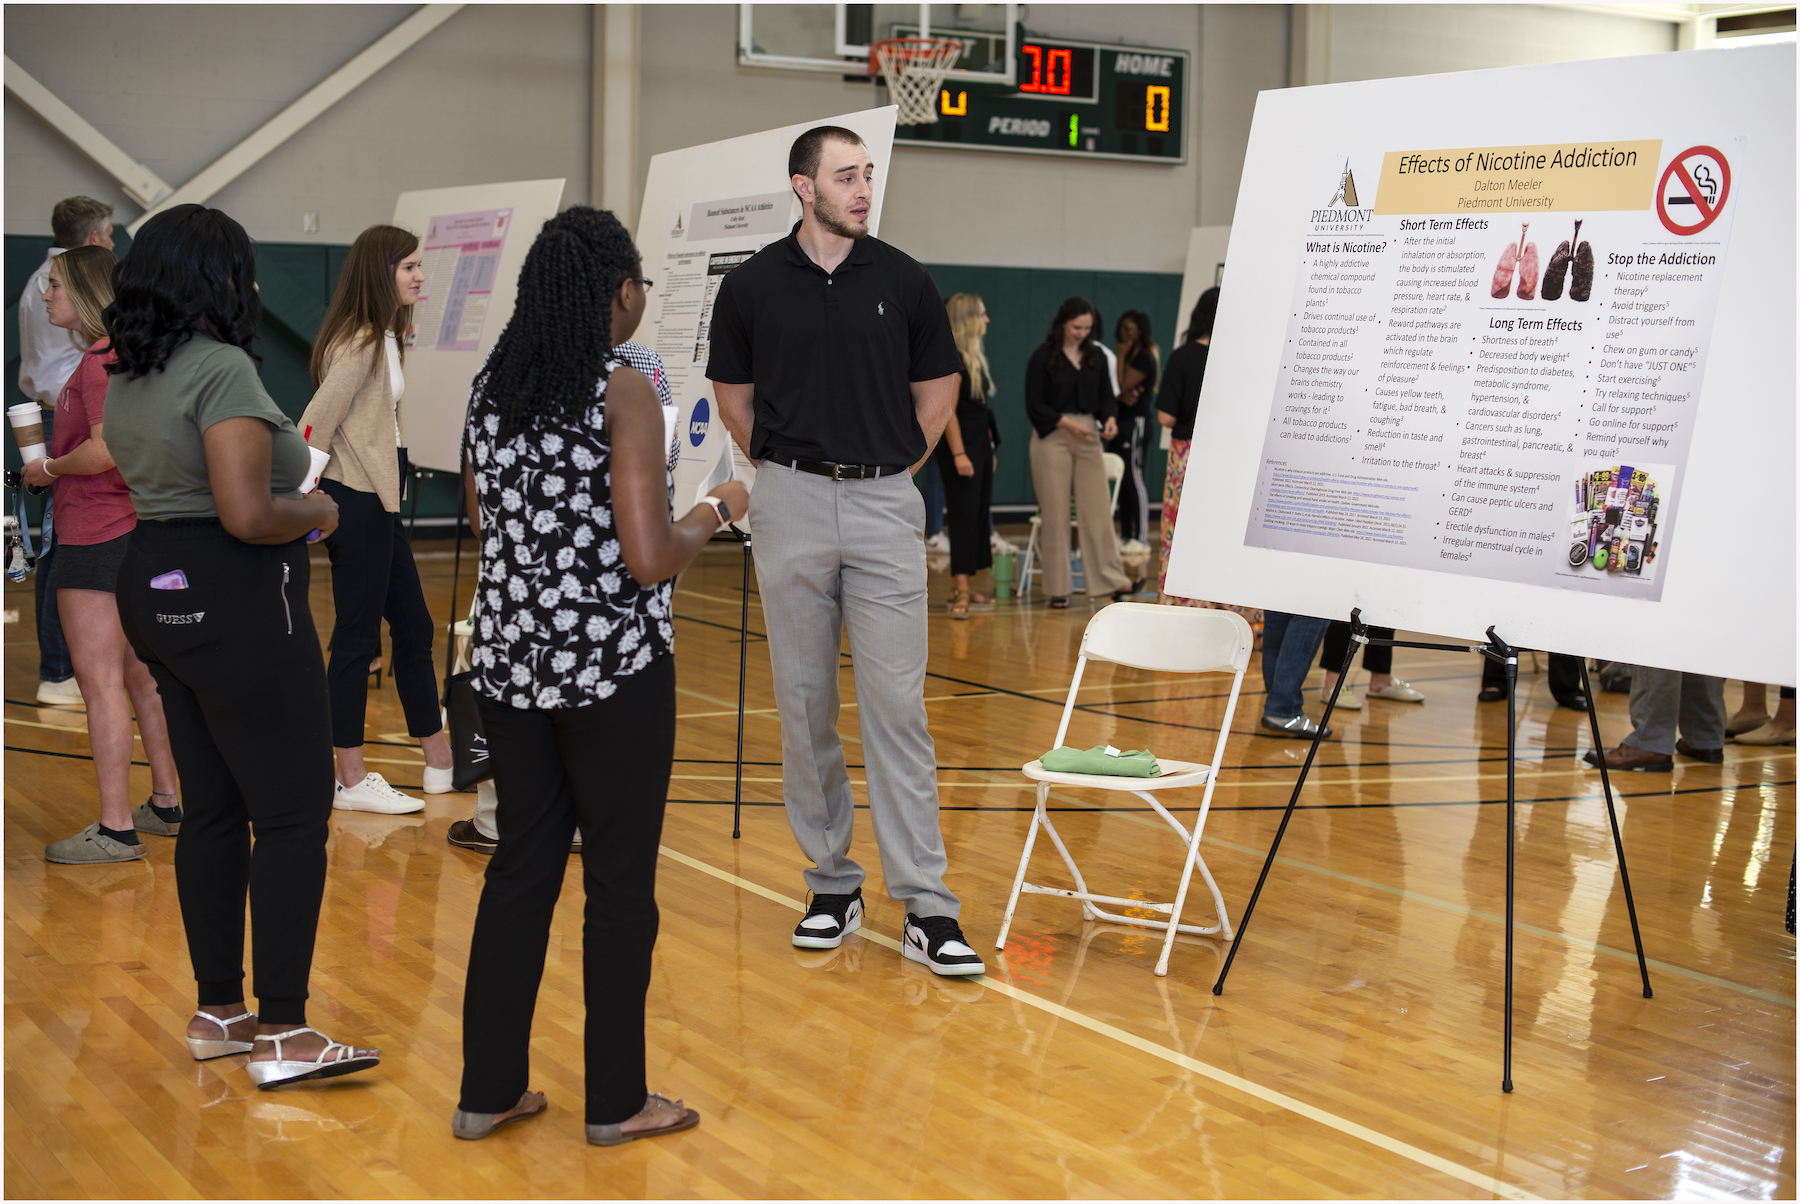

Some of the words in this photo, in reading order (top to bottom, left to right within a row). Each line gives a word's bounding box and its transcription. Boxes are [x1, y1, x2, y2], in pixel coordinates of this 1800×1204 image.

[1115, 53, 1174, 76] HOME
[1146, 85, 1170, 132] 0
[988, 116, 1050, 137] PERIOD
[1069, 113, 1078, 148] 1
[1399, 154, 1450, 174] Effects
[1455, 152, 1474, 172] of
[1476, 150, 1546, 171] Nicotine
[1550, 148, 1638, 168] Addiction
[1474, 180, 1505, 191] Dalton
[1507, 179, 1543, 190] Meeler
[1458, 197, 1503, 208] Piedmont
[1506, 196, 1554, 208] University
[1310, 209, 1374, 222] PIEDMONT
[1400, 219, 1426, 230] Short
[1429, 219, 1452, 230] Term
[1456, 218, 1488, 230] Effects
[1404, 237, 1422, 245] After
[1423, 237, 1434, 245] the
[1436, 236, 1456, 245] initial
[1306, 242, 1330, 252] What
[1332, 243, 1340, 252] is
[1342, 241, 1387, 253] Nicotine?
[1402, 250, 1435, 259] inhalation
[1446, 250, 1486, 260] absorption,
[1608, 252, 1634, 267] Stop
[1637, 252, 1656, 265] the
[1659, 252, 1716, 265] Addiction
[1320, 259, 1339, 269] highly
[1340, 259, 1369, 267] addictive
[1399, 264, 1410, 273] the
[1412, 265, 1429, 274] body
[1438, 264, 1475, 273] stimulated
[1310, 272, 1339, 281] chemical
[1340, 273, 1375, 282] compound
[1396, 279, 1421, 288] causing
[1423, 278, 1456, 287] increased
[1458, 278, 1479, 287] blood
[1617, 272, 1650, 281] Nicotine
[1652, 272, 1703, 282] replacement
[1308, 285, 1327, 294] found
[1336, 285, 1362, 294] tobacco
[1393, 293, 1424, 301] pressure,
[1426, 292, 1444, 300] heart
[1465, 293, 1470, 301] &
[1611, 301, 1634, 310] Avoid
[1304, 312, 1323, 320] Drives
[1324, 313, 1354, 321] continual
[1369, 313, 1376, 322] of
[1609, 316, 1639, 325] Distract
[1640, 317, 1674, 327] yourself
[1675, 317, 1695, 326] from
[1389, 319, 1414, 328] Reward
[1415, 320, 1448, 330] pathways
[1490, 317, 1515, 331] Long
[1518, 318, 1543, 330] Term
[1546, 318, 1583, 331] Effects
[1298, 338, 1331, 347] Contained
[1332, 339, 1338, 347] in
[1340, 339, 1348, 348] all
[1386, 333, 1416, 342] activated
[1418, 334, 1425, 342] in
[1427, 334, 1438, 342] the
[1440, 334, 1458, 343] brain
[1383, 347, 1403, 355] which
[1405, 348, 1434, 358] regulate
[1293, 364, 1319, 375] Changes
[1321, 366, 1332, 374] the
[1380, 360, 1429, 371] reinforcement
[1431, 362, 1436, 370] &
[1438, 363, 1465, 373] feelings
[1476, 364, 1529, 375] Predisposition
[1540, 367, 1575, 378] diabetes,
[1291, 377, 1310, 387] brains
[1311, 379, 1343, 390] chemistry
[1597, 374, 1616, 383] Start
[1474, 380, 1510, 389] metabolic
[1511, 381, 1551, 392] syndrome,
[1375, 387, 1398, 397] Causes
[1400, 389, 1422, 398] yellow
[1424, 390, 1445, 400] teeth,
[1471, 392, 1521, 405] hypertension,
[1523, 395, 1529, 404] &
[1372, 401, 1397, 411] fatigue,
[1400, 402, 1412, 411] bad
[1414, 403, 1438, 414] breath,
[1441, 405, 1447, 414] &
[1592, 403, 1606, 412] Call
[1608, 404, 1620, 413] for
[690, 422, 708, 434] NCAA
[1283, 417, 1291, 425] All
[1293, 418, 1317, 427] tobacco
[1318, 420, 1347, 429] products
[1465, 421, 1494, 432] Cancers
[1496, 422, 1512, 433] such
[1524, 425, 1543, 436] lung,
[1367, 428, 1401, 439] Reduction
[1403, 431, 1409, 439] in
[1411, 432, 1428, 441] taste
[1430, 433, 1443, 442] and
[1586, 432, 1616, 443] Remind
[1618, 435, 1651, 445] yourself
[1652, 437, 1669, 448] why
[1462, 436, 1520, 449] gastrointestinal,
[1522, 440, 1564, 453] pancreatic,
[1567, 443, 1573, 452] &
[1457, 464, 1477, 474] Heart
[1479, 466, 1505, 476] attacks
[1506, 468, 1513, 477] &
[1515, 471, 1560, 482] suppression
[1452, 493, 1465, 502] Can
[1466, 496, 1488, 504] cause
[1489, 497, 1513, 508] peptic
[1515, 499, 1536, 510] ulcers
[1538, 502, 1554, 511] and
[1443, 535, 1474, 547] Irregular
[1476, 540, 1513, 552] menstrual
[1515, 545, 1534, 555] cycle
[1536, 547, 1543, 556] in
[156, 613, 192, 624] GUESS
